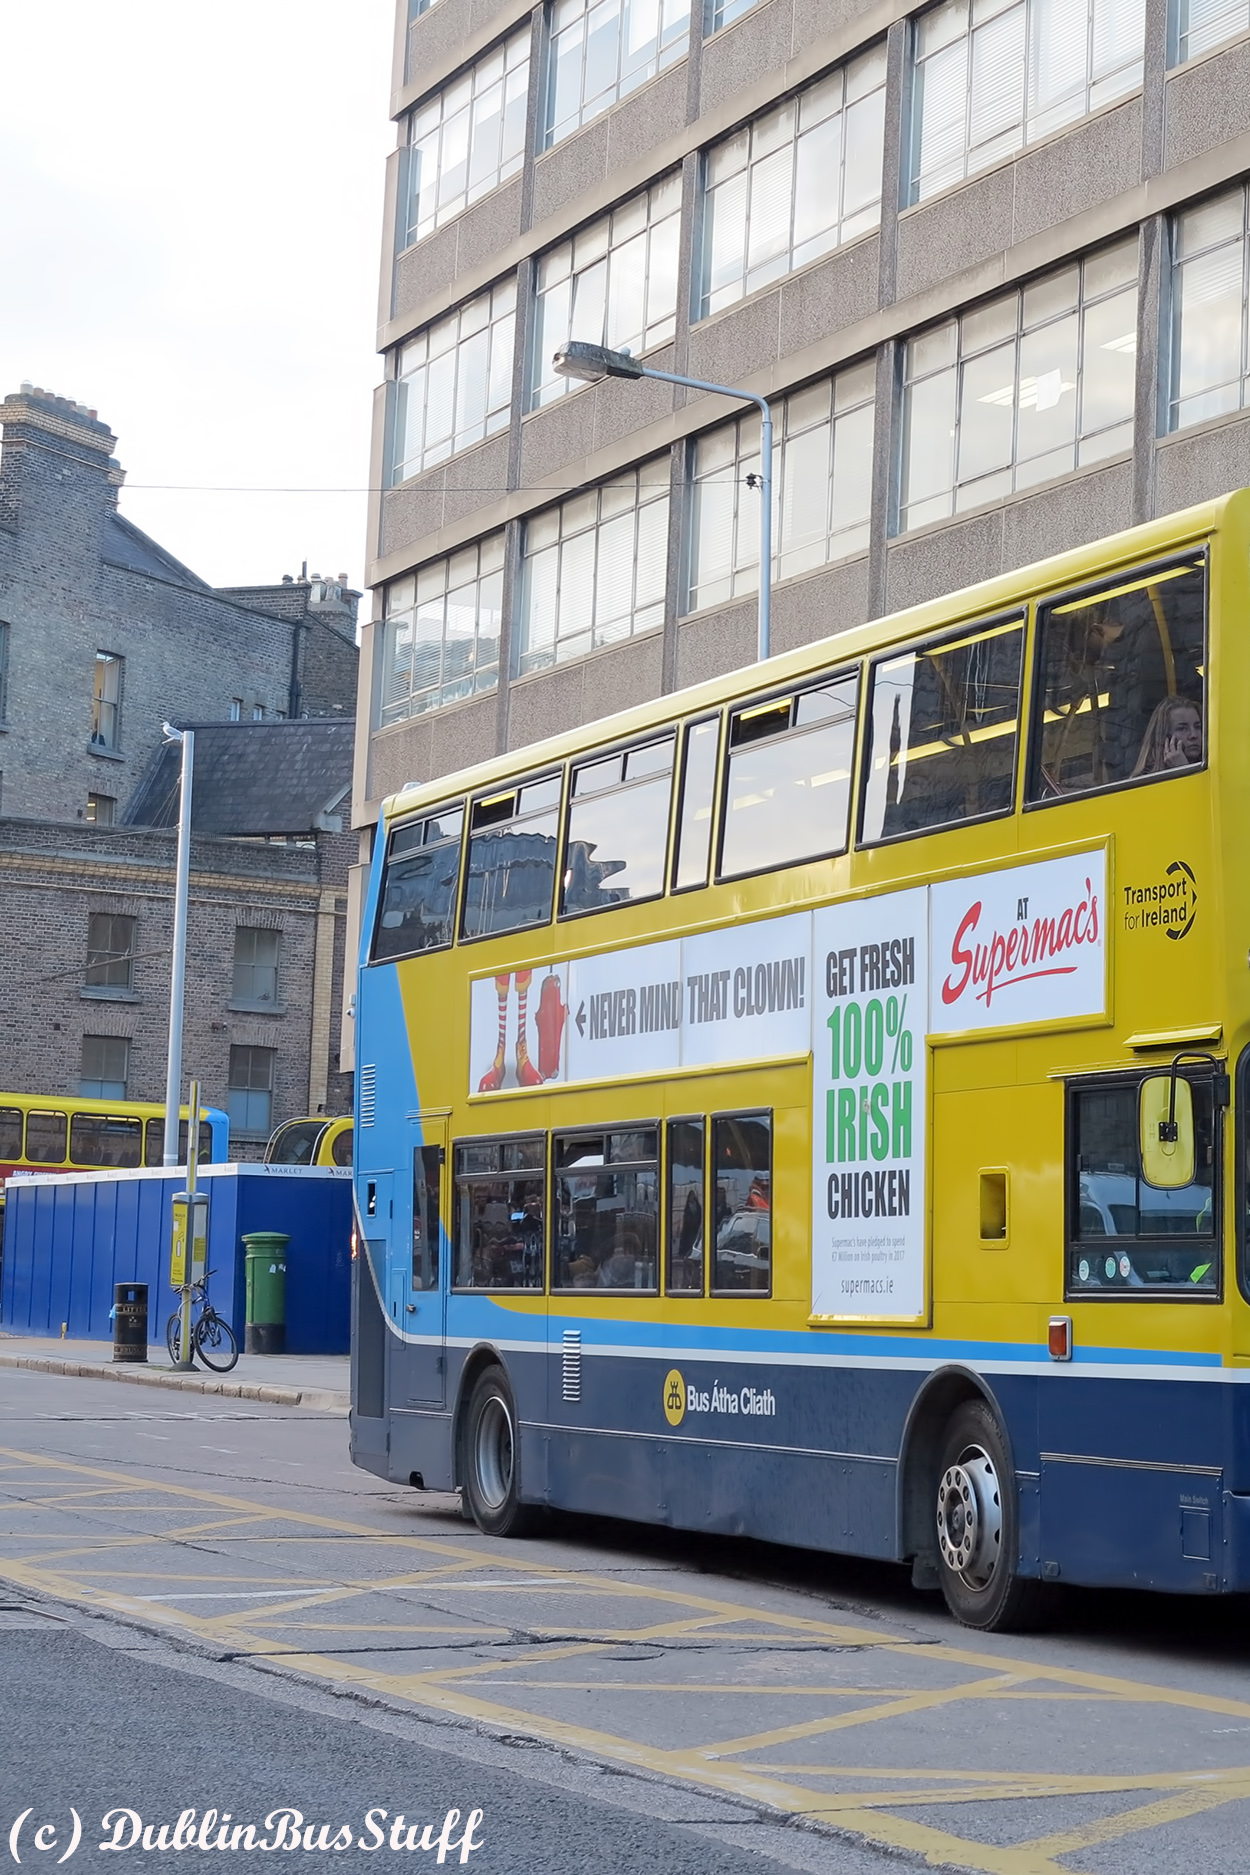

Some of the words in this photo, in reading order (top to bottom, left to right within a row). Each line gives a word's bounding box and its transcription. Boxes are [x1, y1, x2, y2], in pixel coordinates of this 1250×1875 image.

[1016, 897, 1029, 921] AT
[1124, 877, 1187, 905] Transport
[1124, 912, 1140, 930] for
[1142, 901, 1187, 927] Ireland
[942, 877, 1098, 1008] Supermac's
[826, 947, 857, 998] GET
[860, 936, 915, 992] FRESH
[589, 988, 636, 1040] NEVER
[639, 981, 683, 1034] MIND
[687, 970, 730, 1024] THAT
[733, 956, 805, 1018] CLOWN!
[827, 993, 913, 1080] 100%
[826, 1081, 912, 1164] IRISH
[271, 1167, 303, 1175] MARLET
[827, 1169, 910, 1220] CHICKEN
[841, 1275, 893, 1297] supermacs.ie
[687, 1385, 709, 1412] Bus
[711, 1379, 738, 1414] Átha
[740, 1387, 776, 1416] Cliath
